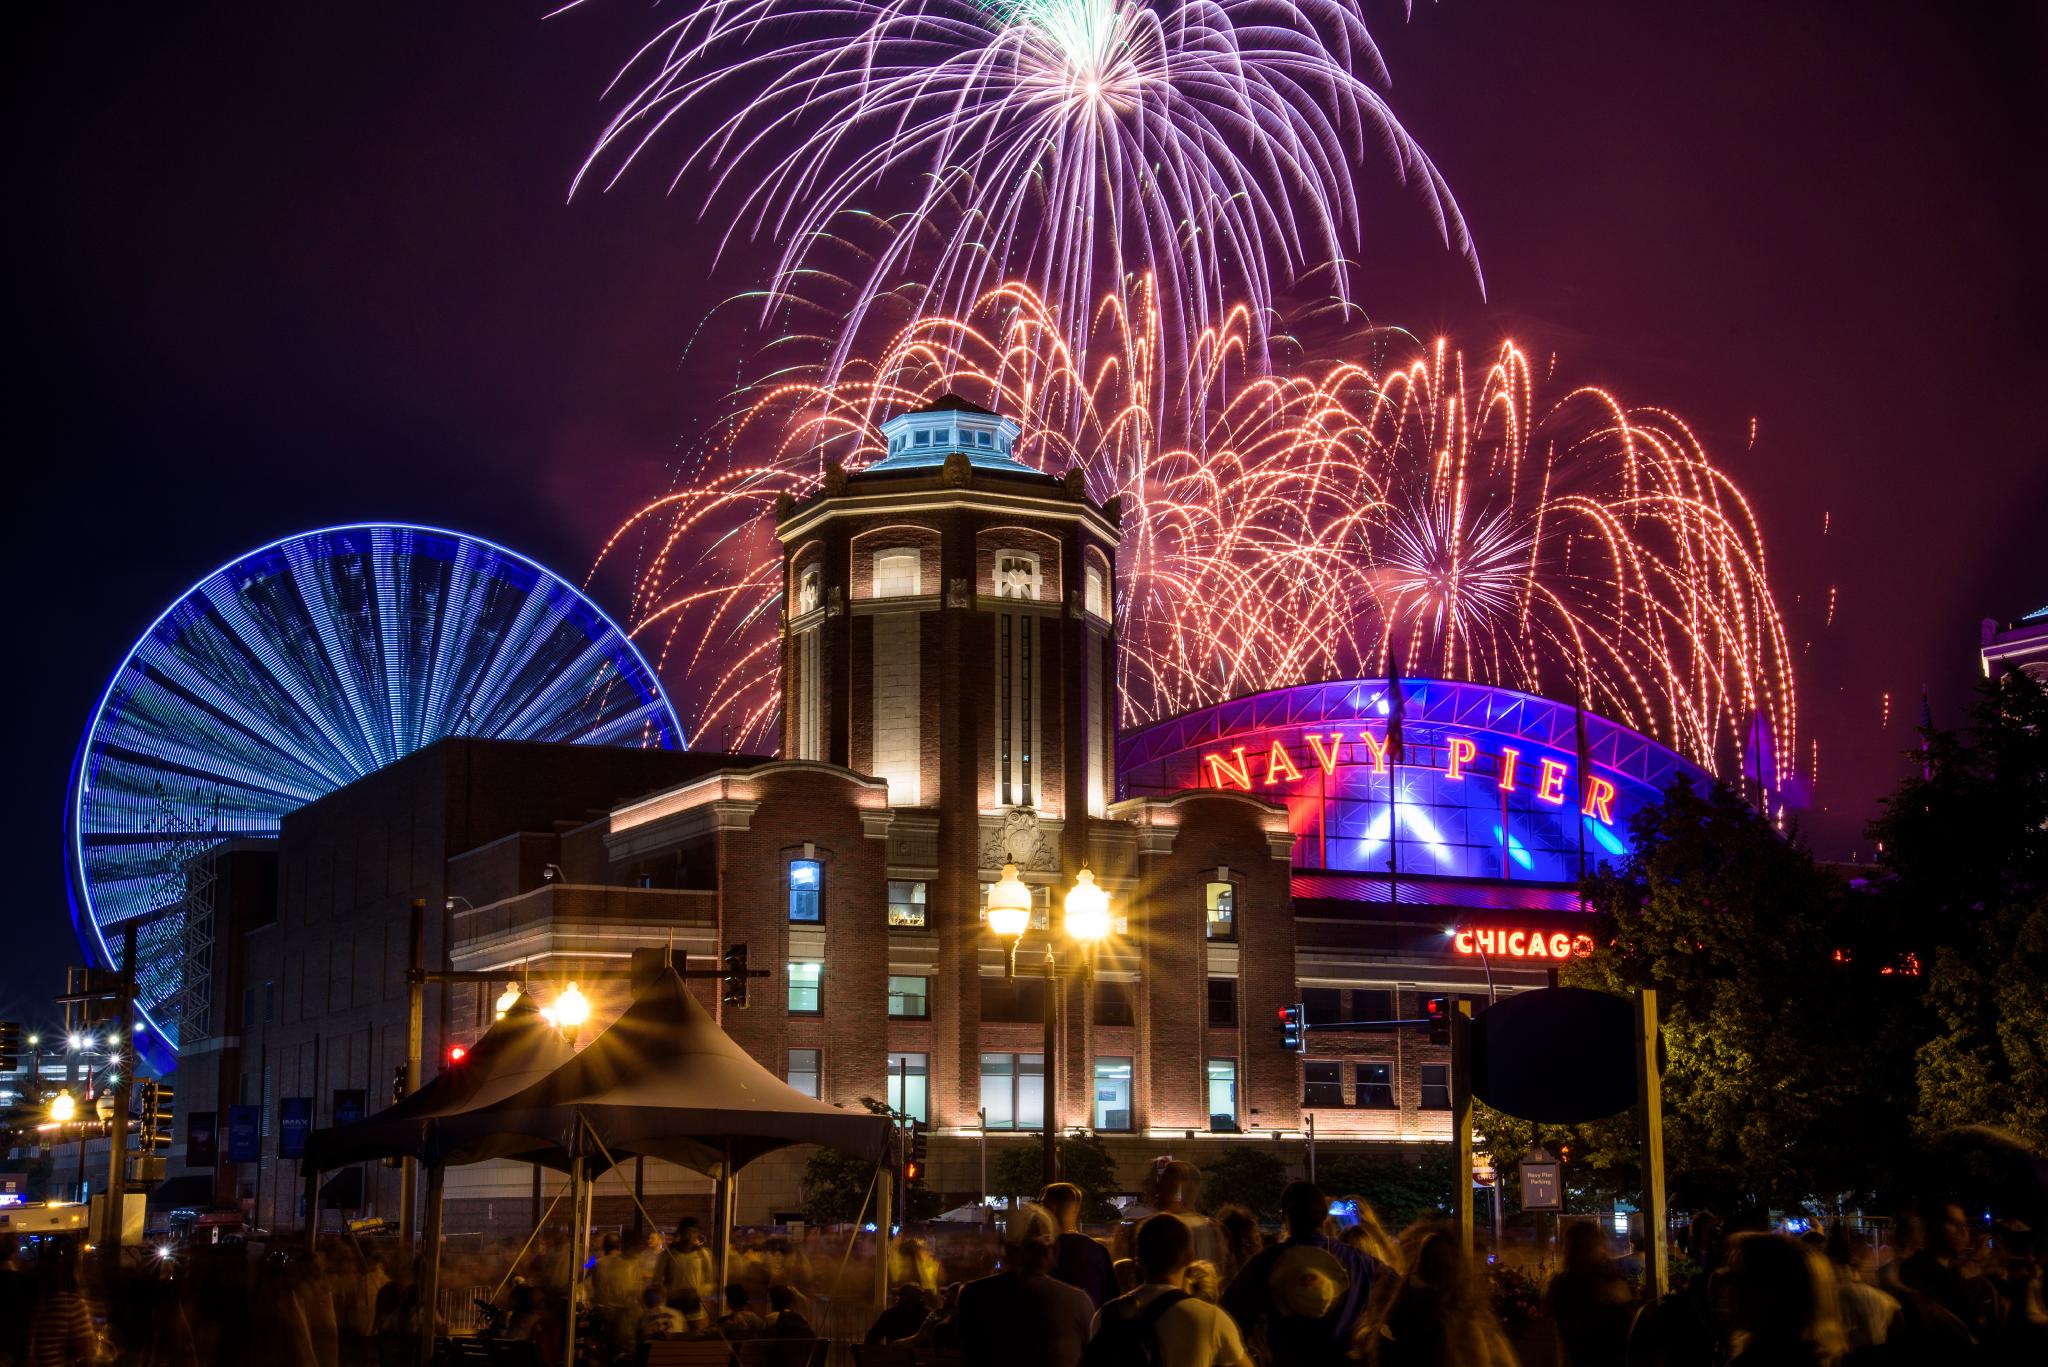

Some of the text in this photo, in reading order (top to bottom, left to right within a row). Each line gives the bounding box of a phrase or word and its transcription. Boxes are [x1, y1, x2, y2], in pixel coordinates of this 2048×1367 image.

[1205, 731, 1613, 826] NAVY PIER
[1455, 930, 1594, 958] CHICAGO
[282, 1119, 309, 1127] IMAX
